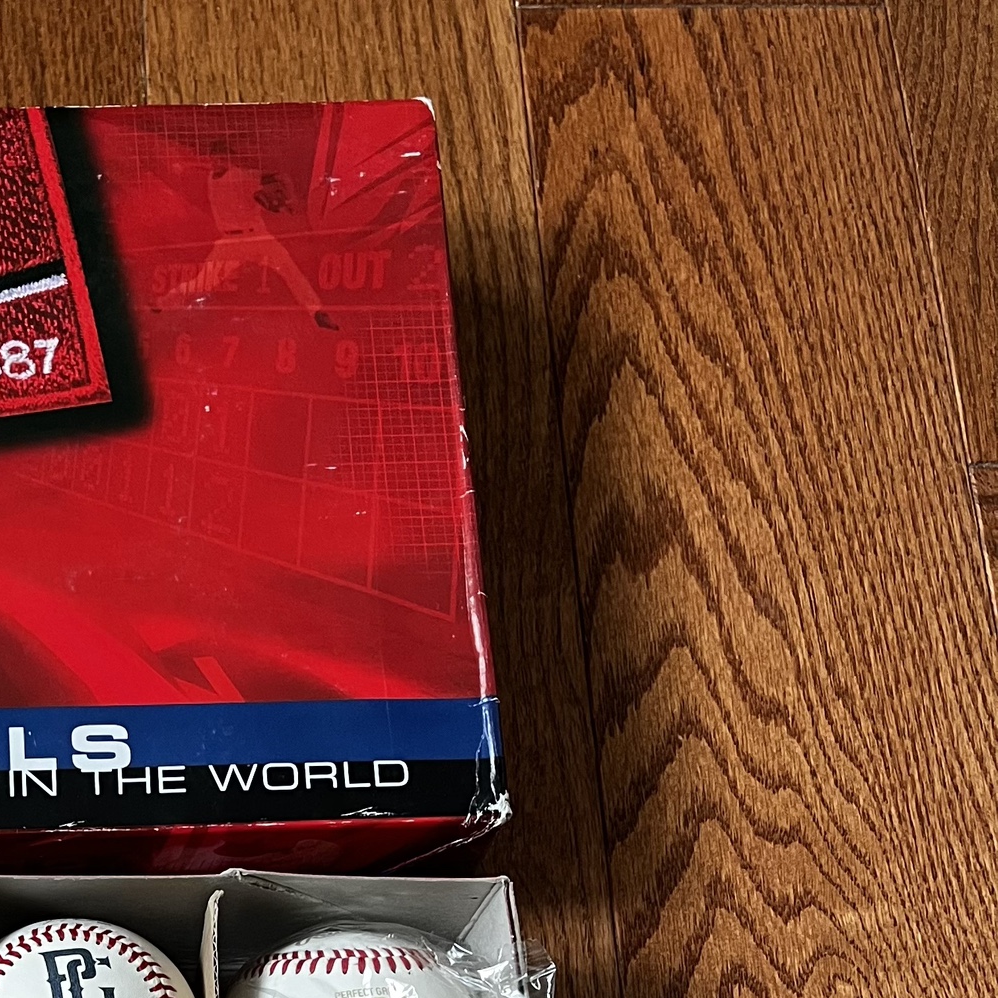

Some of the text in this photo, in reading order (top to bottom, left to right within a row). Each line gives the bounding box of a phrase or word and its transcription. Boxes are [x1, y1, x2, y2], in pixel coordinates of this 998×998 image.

[318, 249, 393, 291] OUT
[222, 335, 241, 368] 7
[333, 339, 359, 379] 9
[9, 768, 57, 798] IN
[86, 764, 187, 796] THE
[208, 759, 410, 792] WORLD
